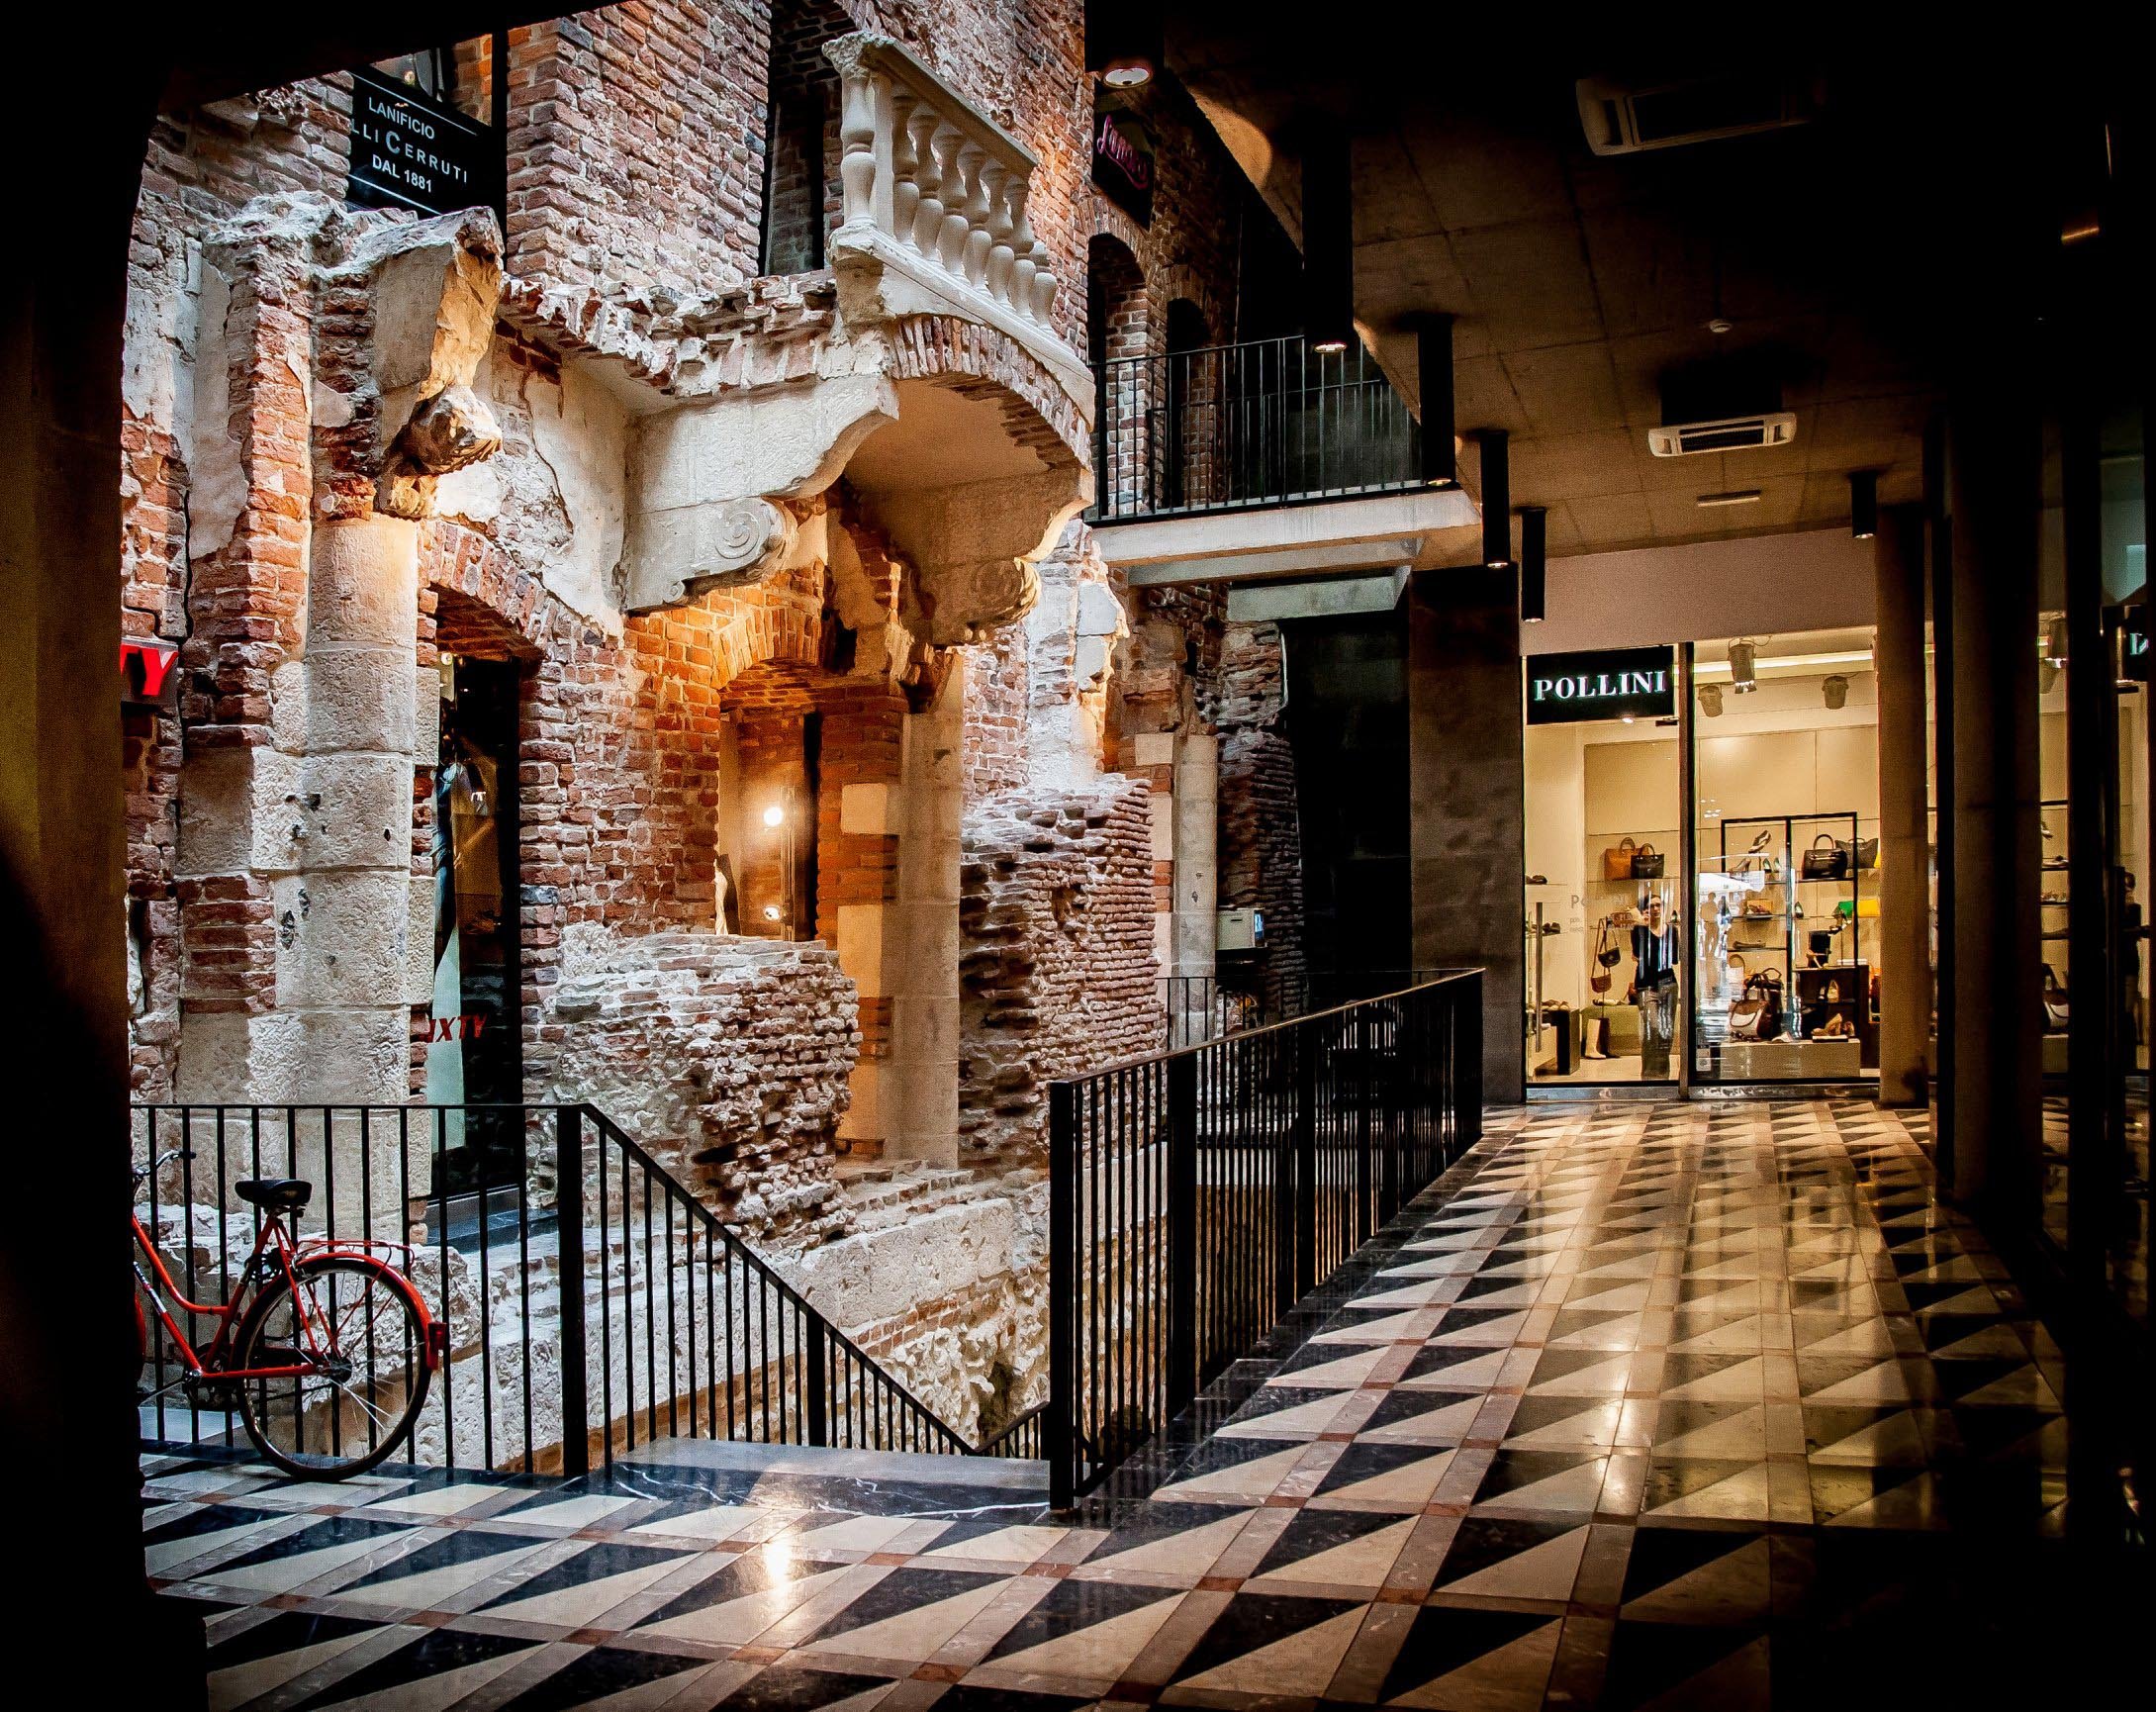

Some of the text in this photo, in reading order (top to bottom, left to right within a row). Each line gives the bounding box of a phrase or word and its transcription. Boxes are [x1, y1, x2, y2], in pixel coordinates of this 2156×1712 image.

[368, 96, 435, 141] LANIFICIO
[372, 153, 432, 193] DAL 1881
[385, 130, 468, 184] CERRUTI
[1534, 670, 1666, 701] POLLINI
